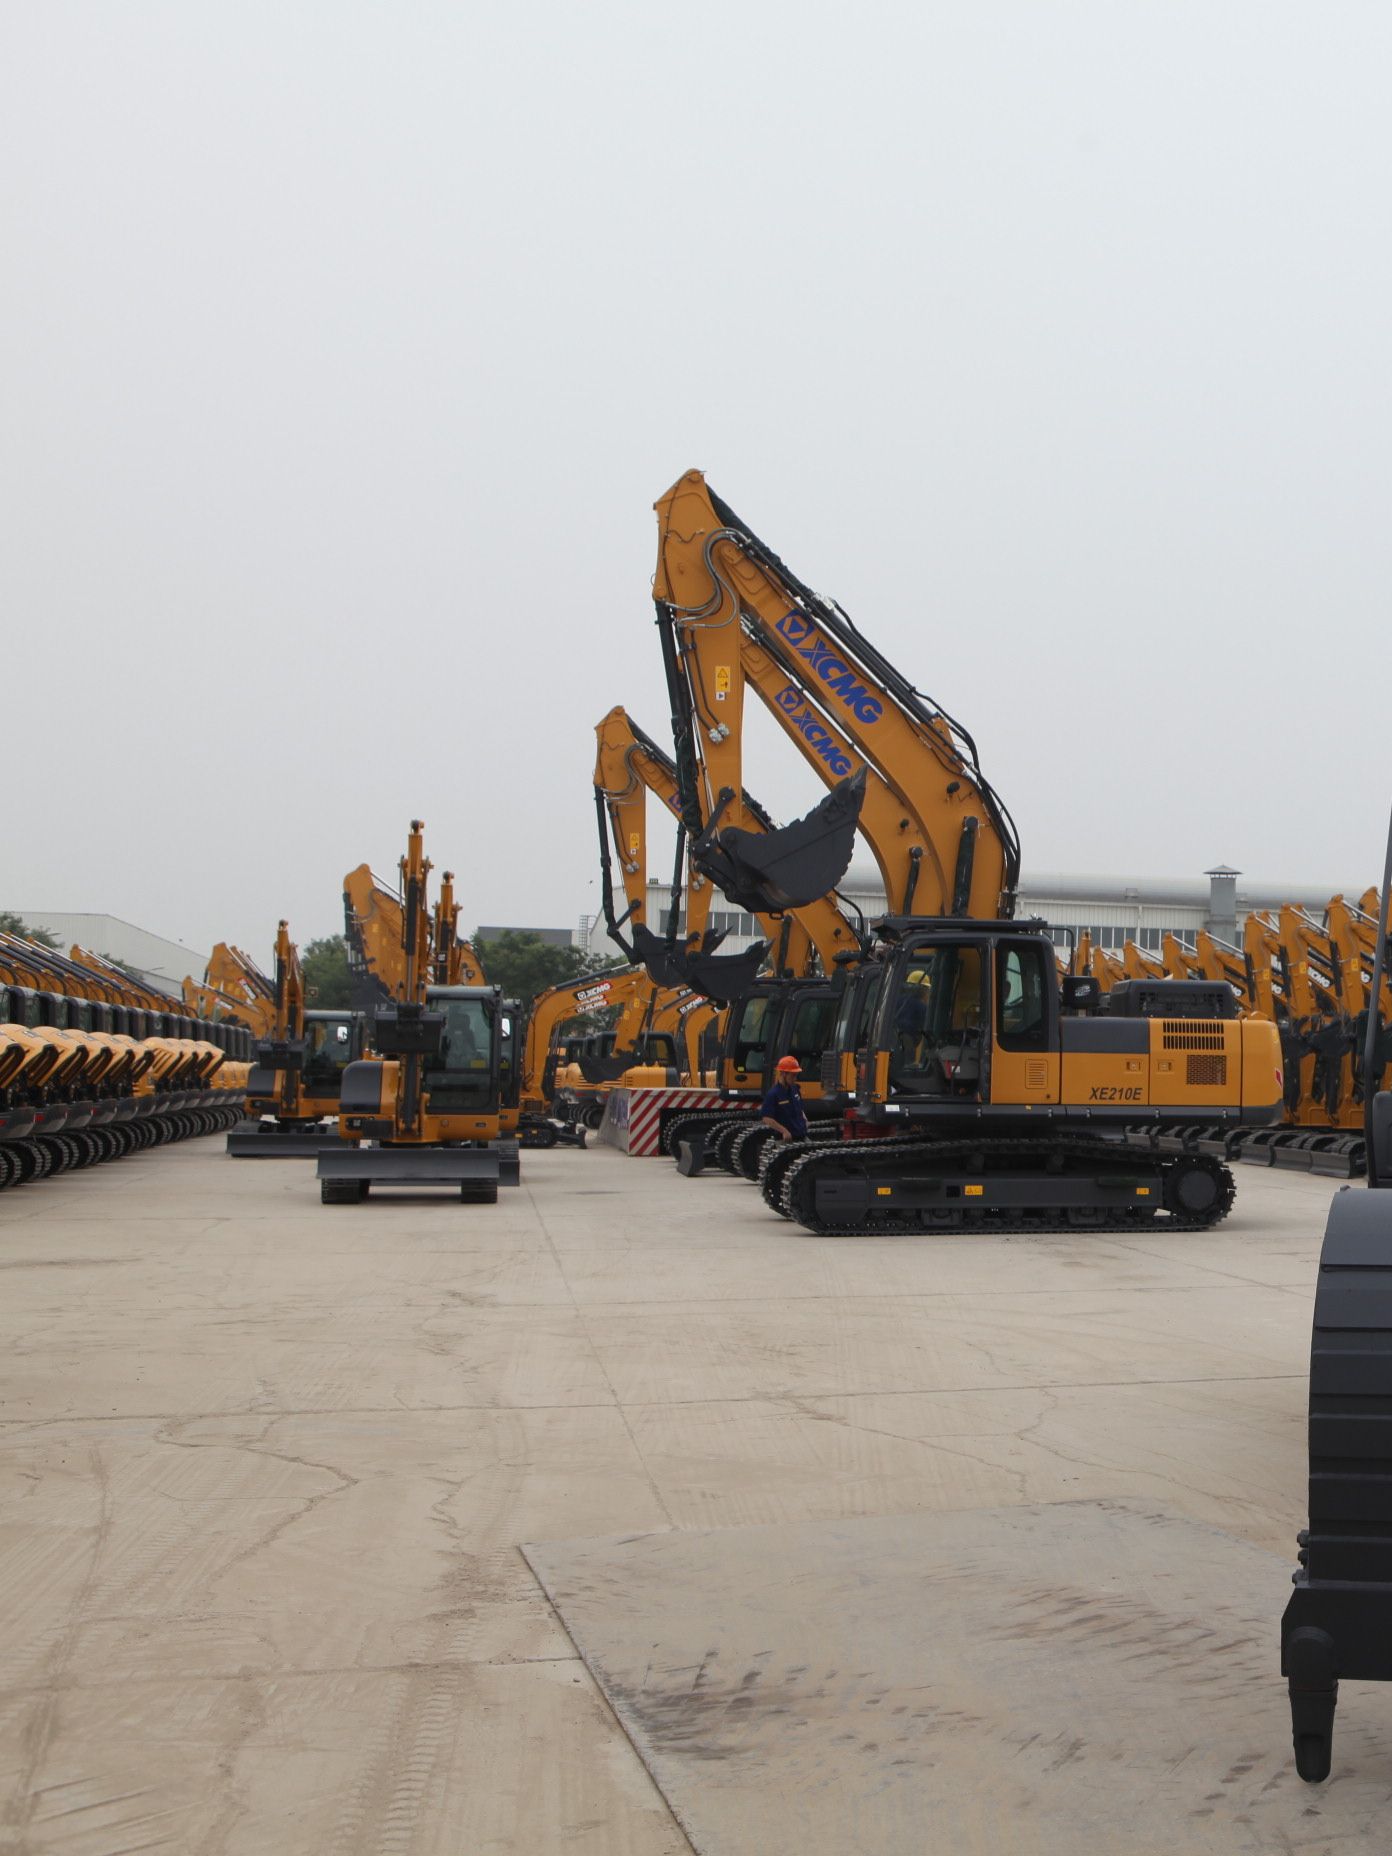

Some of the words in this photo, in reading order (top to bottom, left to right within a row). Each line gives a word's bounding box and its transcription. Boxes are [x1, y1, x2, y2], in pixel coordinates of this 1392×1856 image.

[797, 637, 883, 724] XCMG
[791, 708, 852, 776] XCMG
[1089, 1087, 1143, 1101] XE210E
